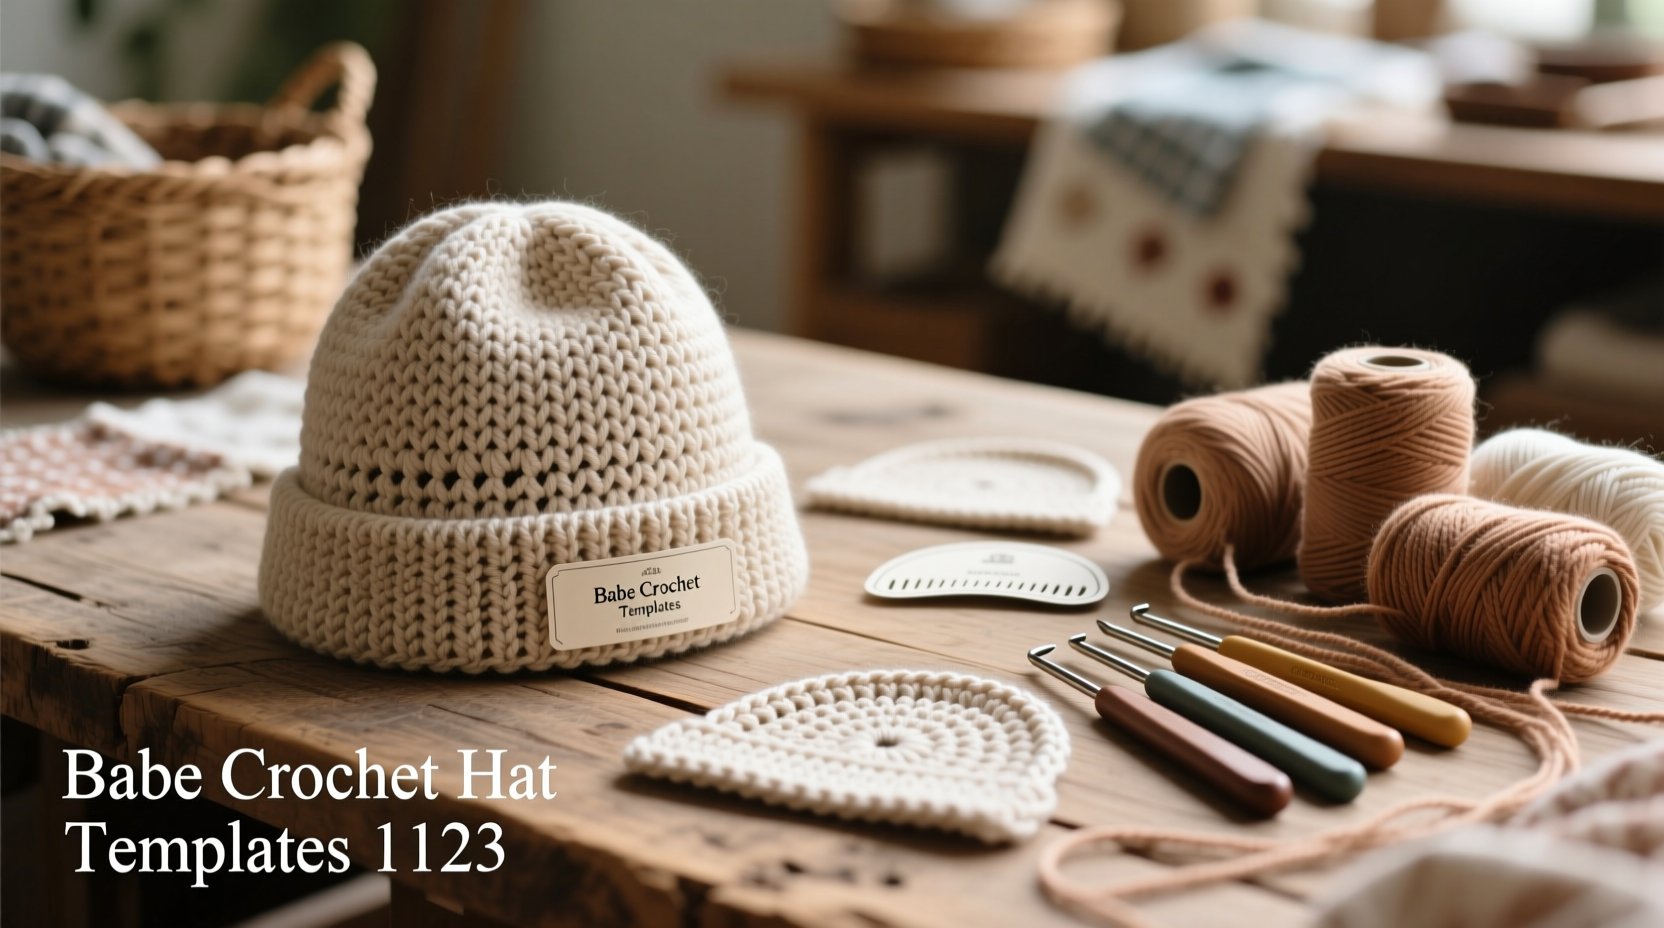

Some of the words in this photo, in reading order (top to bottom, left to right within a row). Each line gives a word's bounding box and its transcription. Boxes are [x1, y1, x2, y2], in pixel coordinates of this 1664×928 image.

[594, 584, 635, 604] Babe
[639, 575, 701, 598] Crochet
[618, 600, 681, 618] Templates
